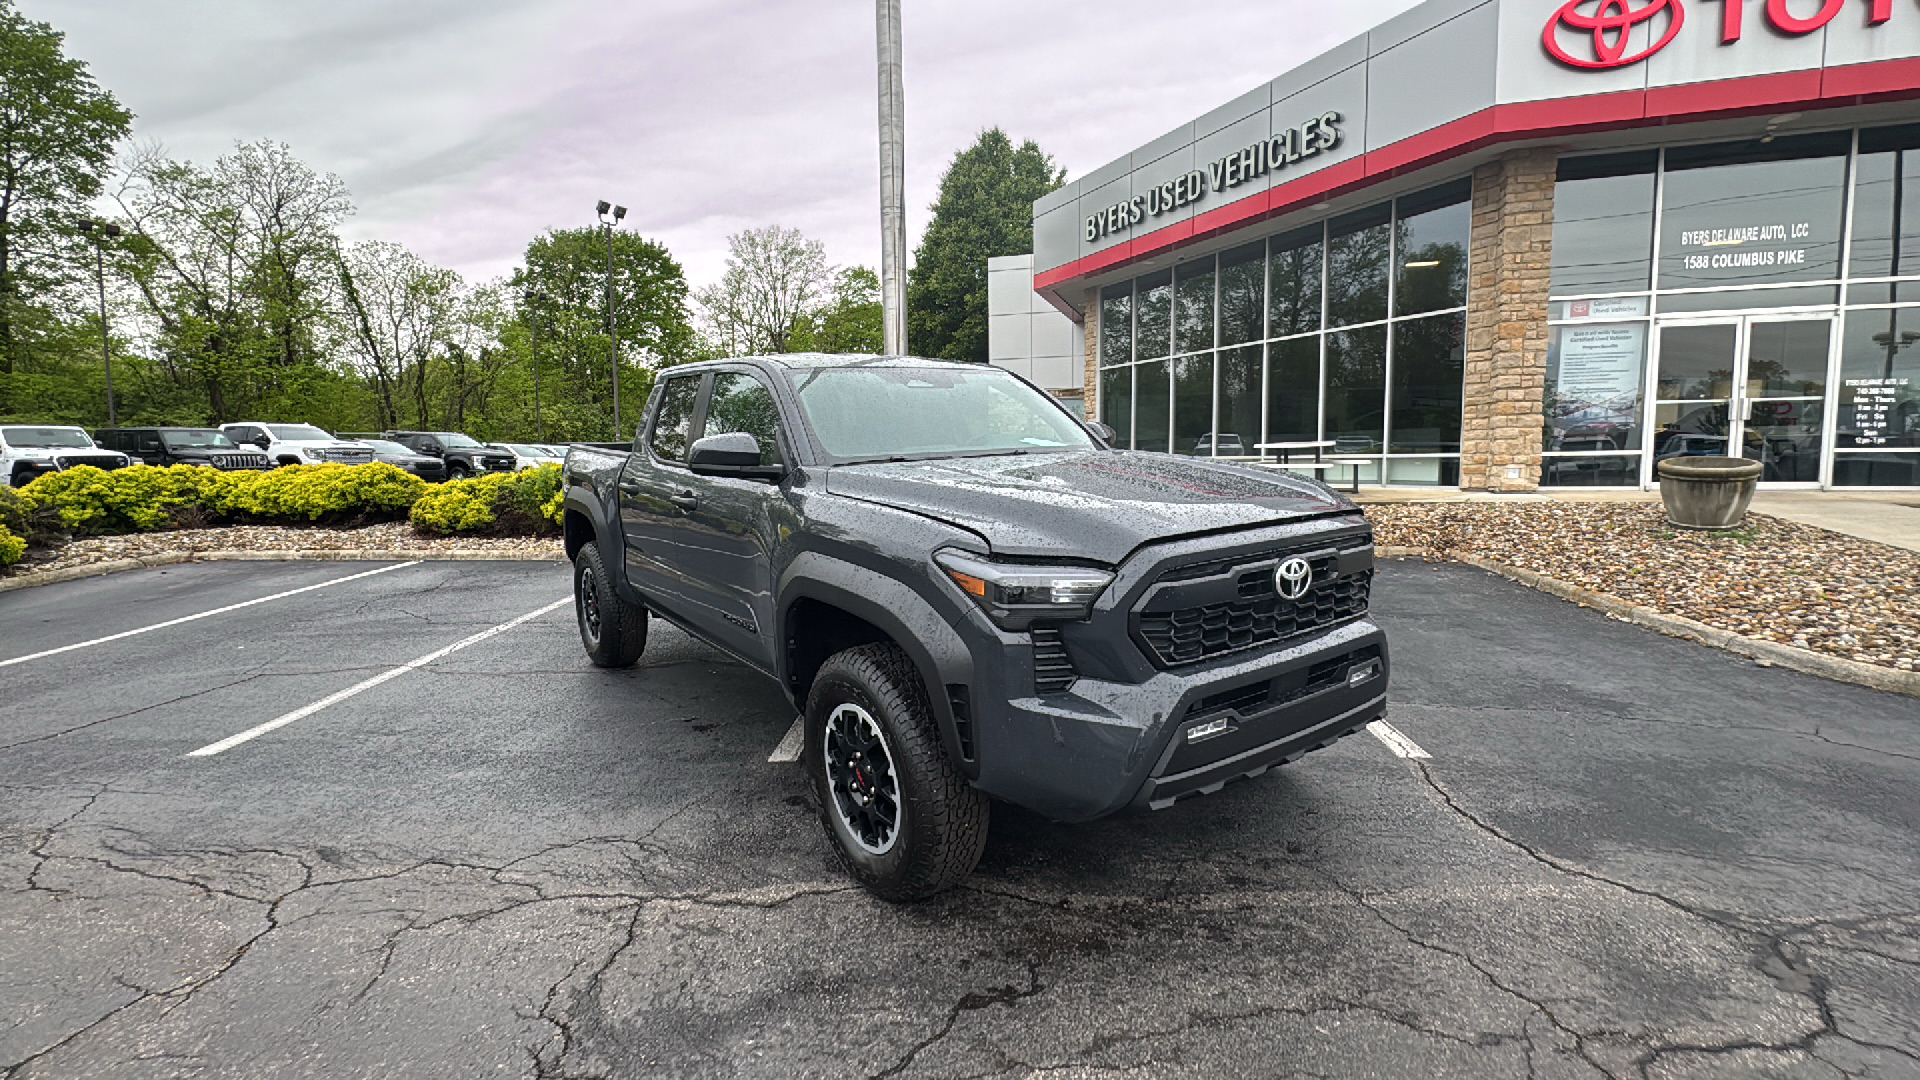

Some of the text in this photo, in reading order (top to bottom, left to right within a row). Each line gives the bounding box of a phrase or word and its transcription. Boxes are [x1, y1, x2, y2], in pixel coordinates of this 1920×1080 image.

[1085, 110, 1343, 242] BYERS USED VEHICLES
[1681, 230, 1709, 245] BYERS
[1711, 226, 1758, 242] DELAWARE
[1760, 224, 1786, 241] AUTO,
[1683, 250, 1805, 269] 1588 COLUMBUS PIKE
